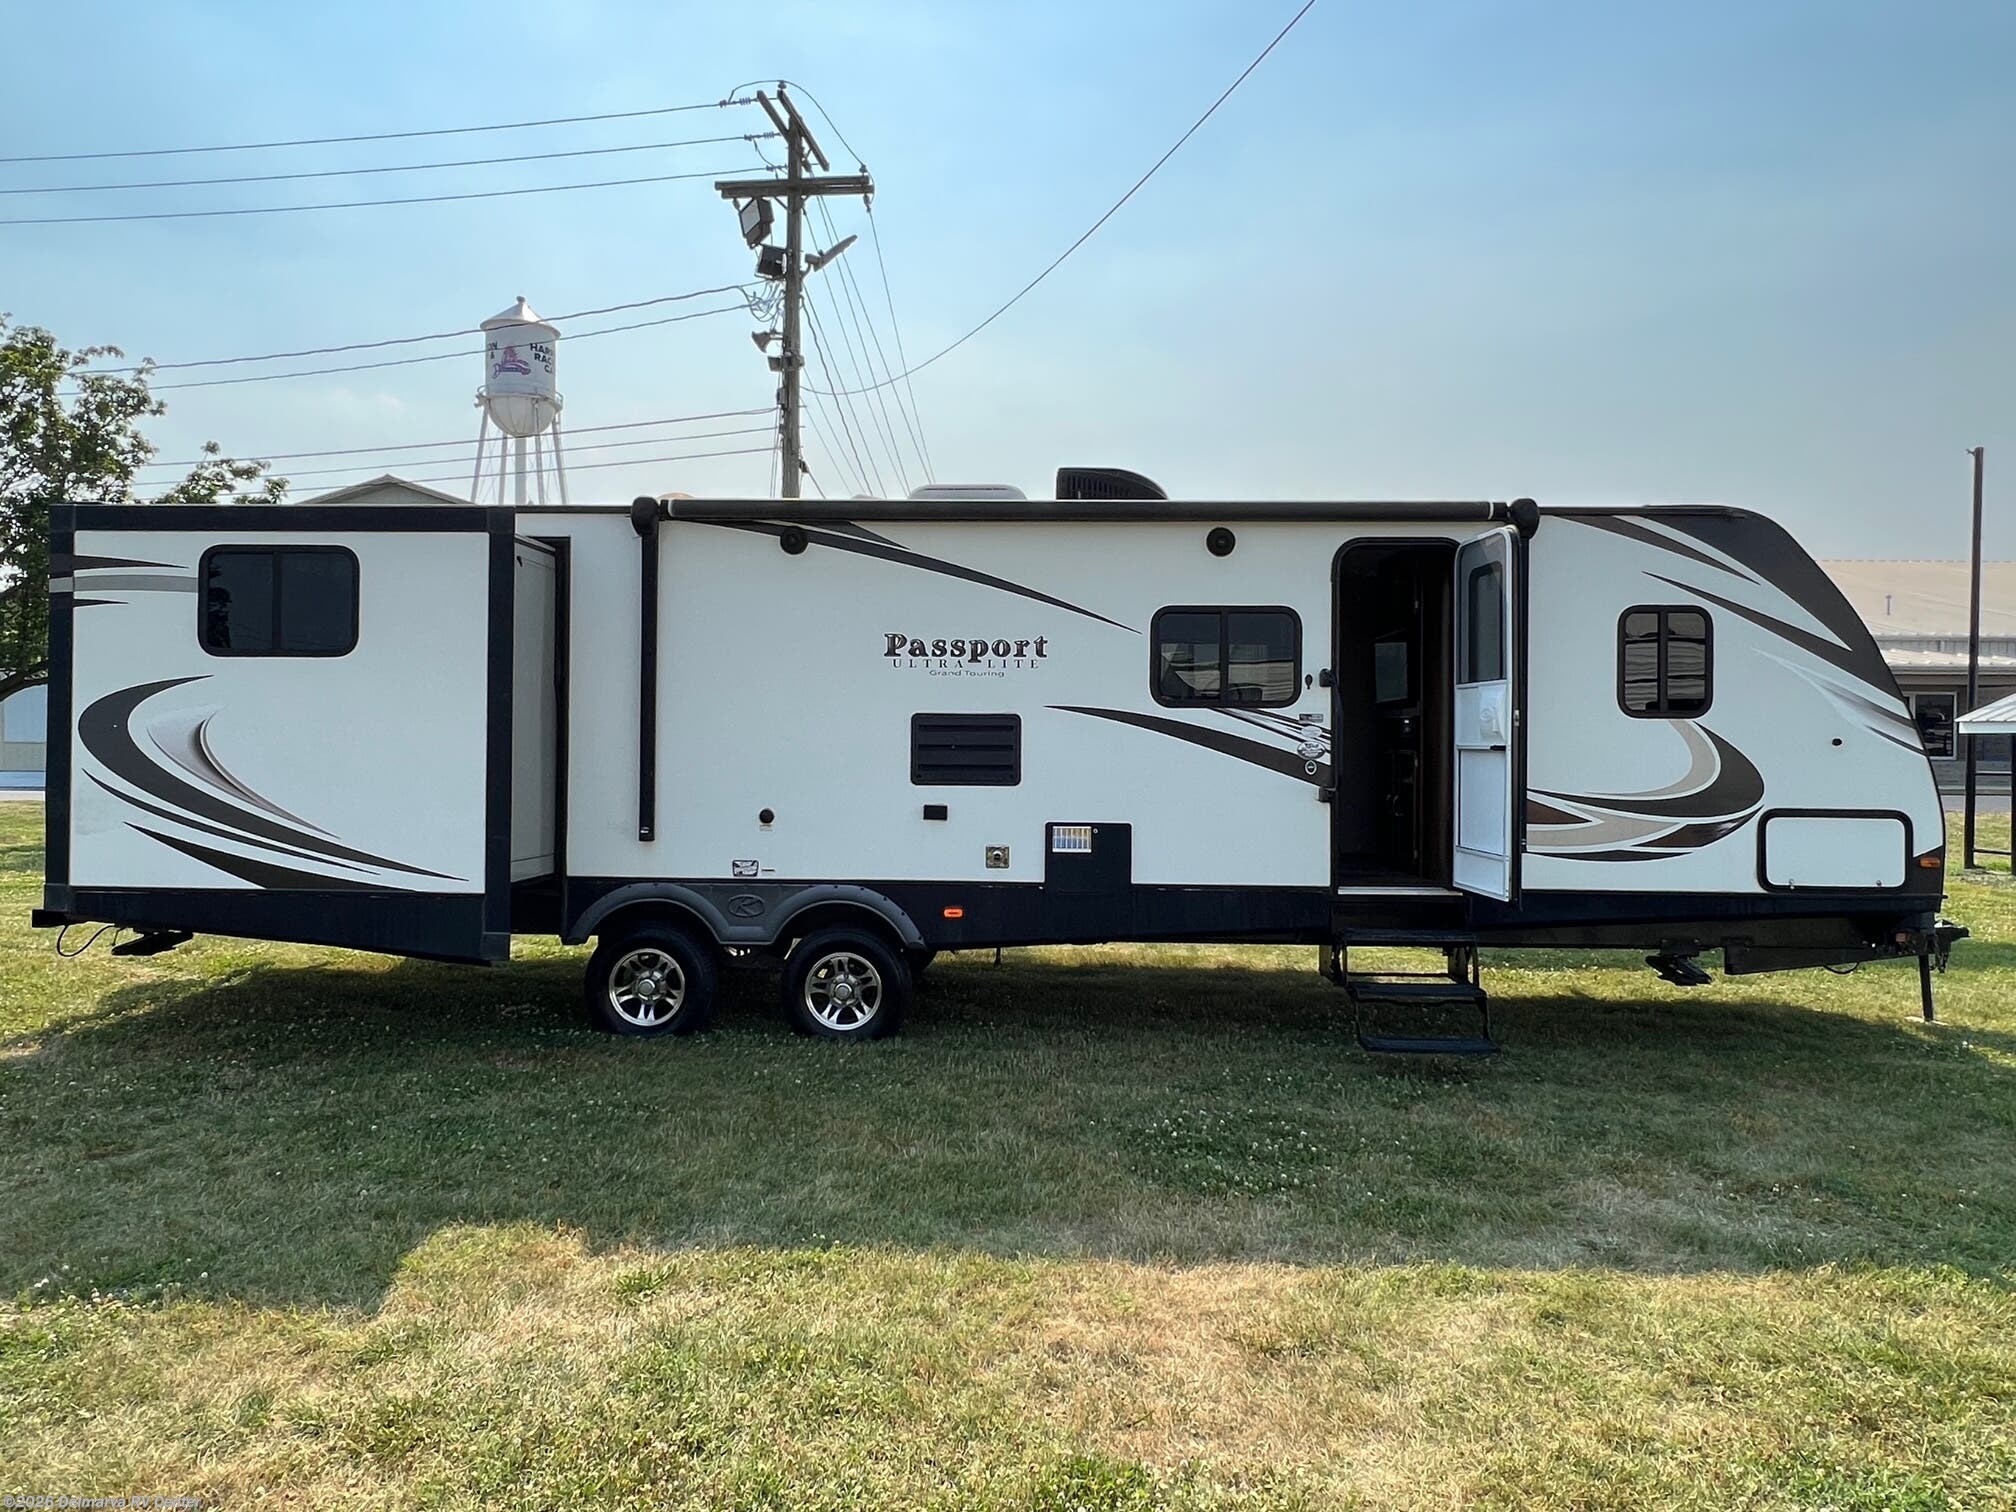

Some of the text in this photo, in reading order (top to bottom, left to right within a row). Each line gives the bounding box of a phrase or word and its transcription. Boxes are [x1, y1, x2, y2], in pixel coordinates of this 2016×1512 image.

[884, 633, 1048, 663] Passport
[893, 659, 1039, 668] ULTRA LITE
[929, 669, 1005, 678] Grand Touring
